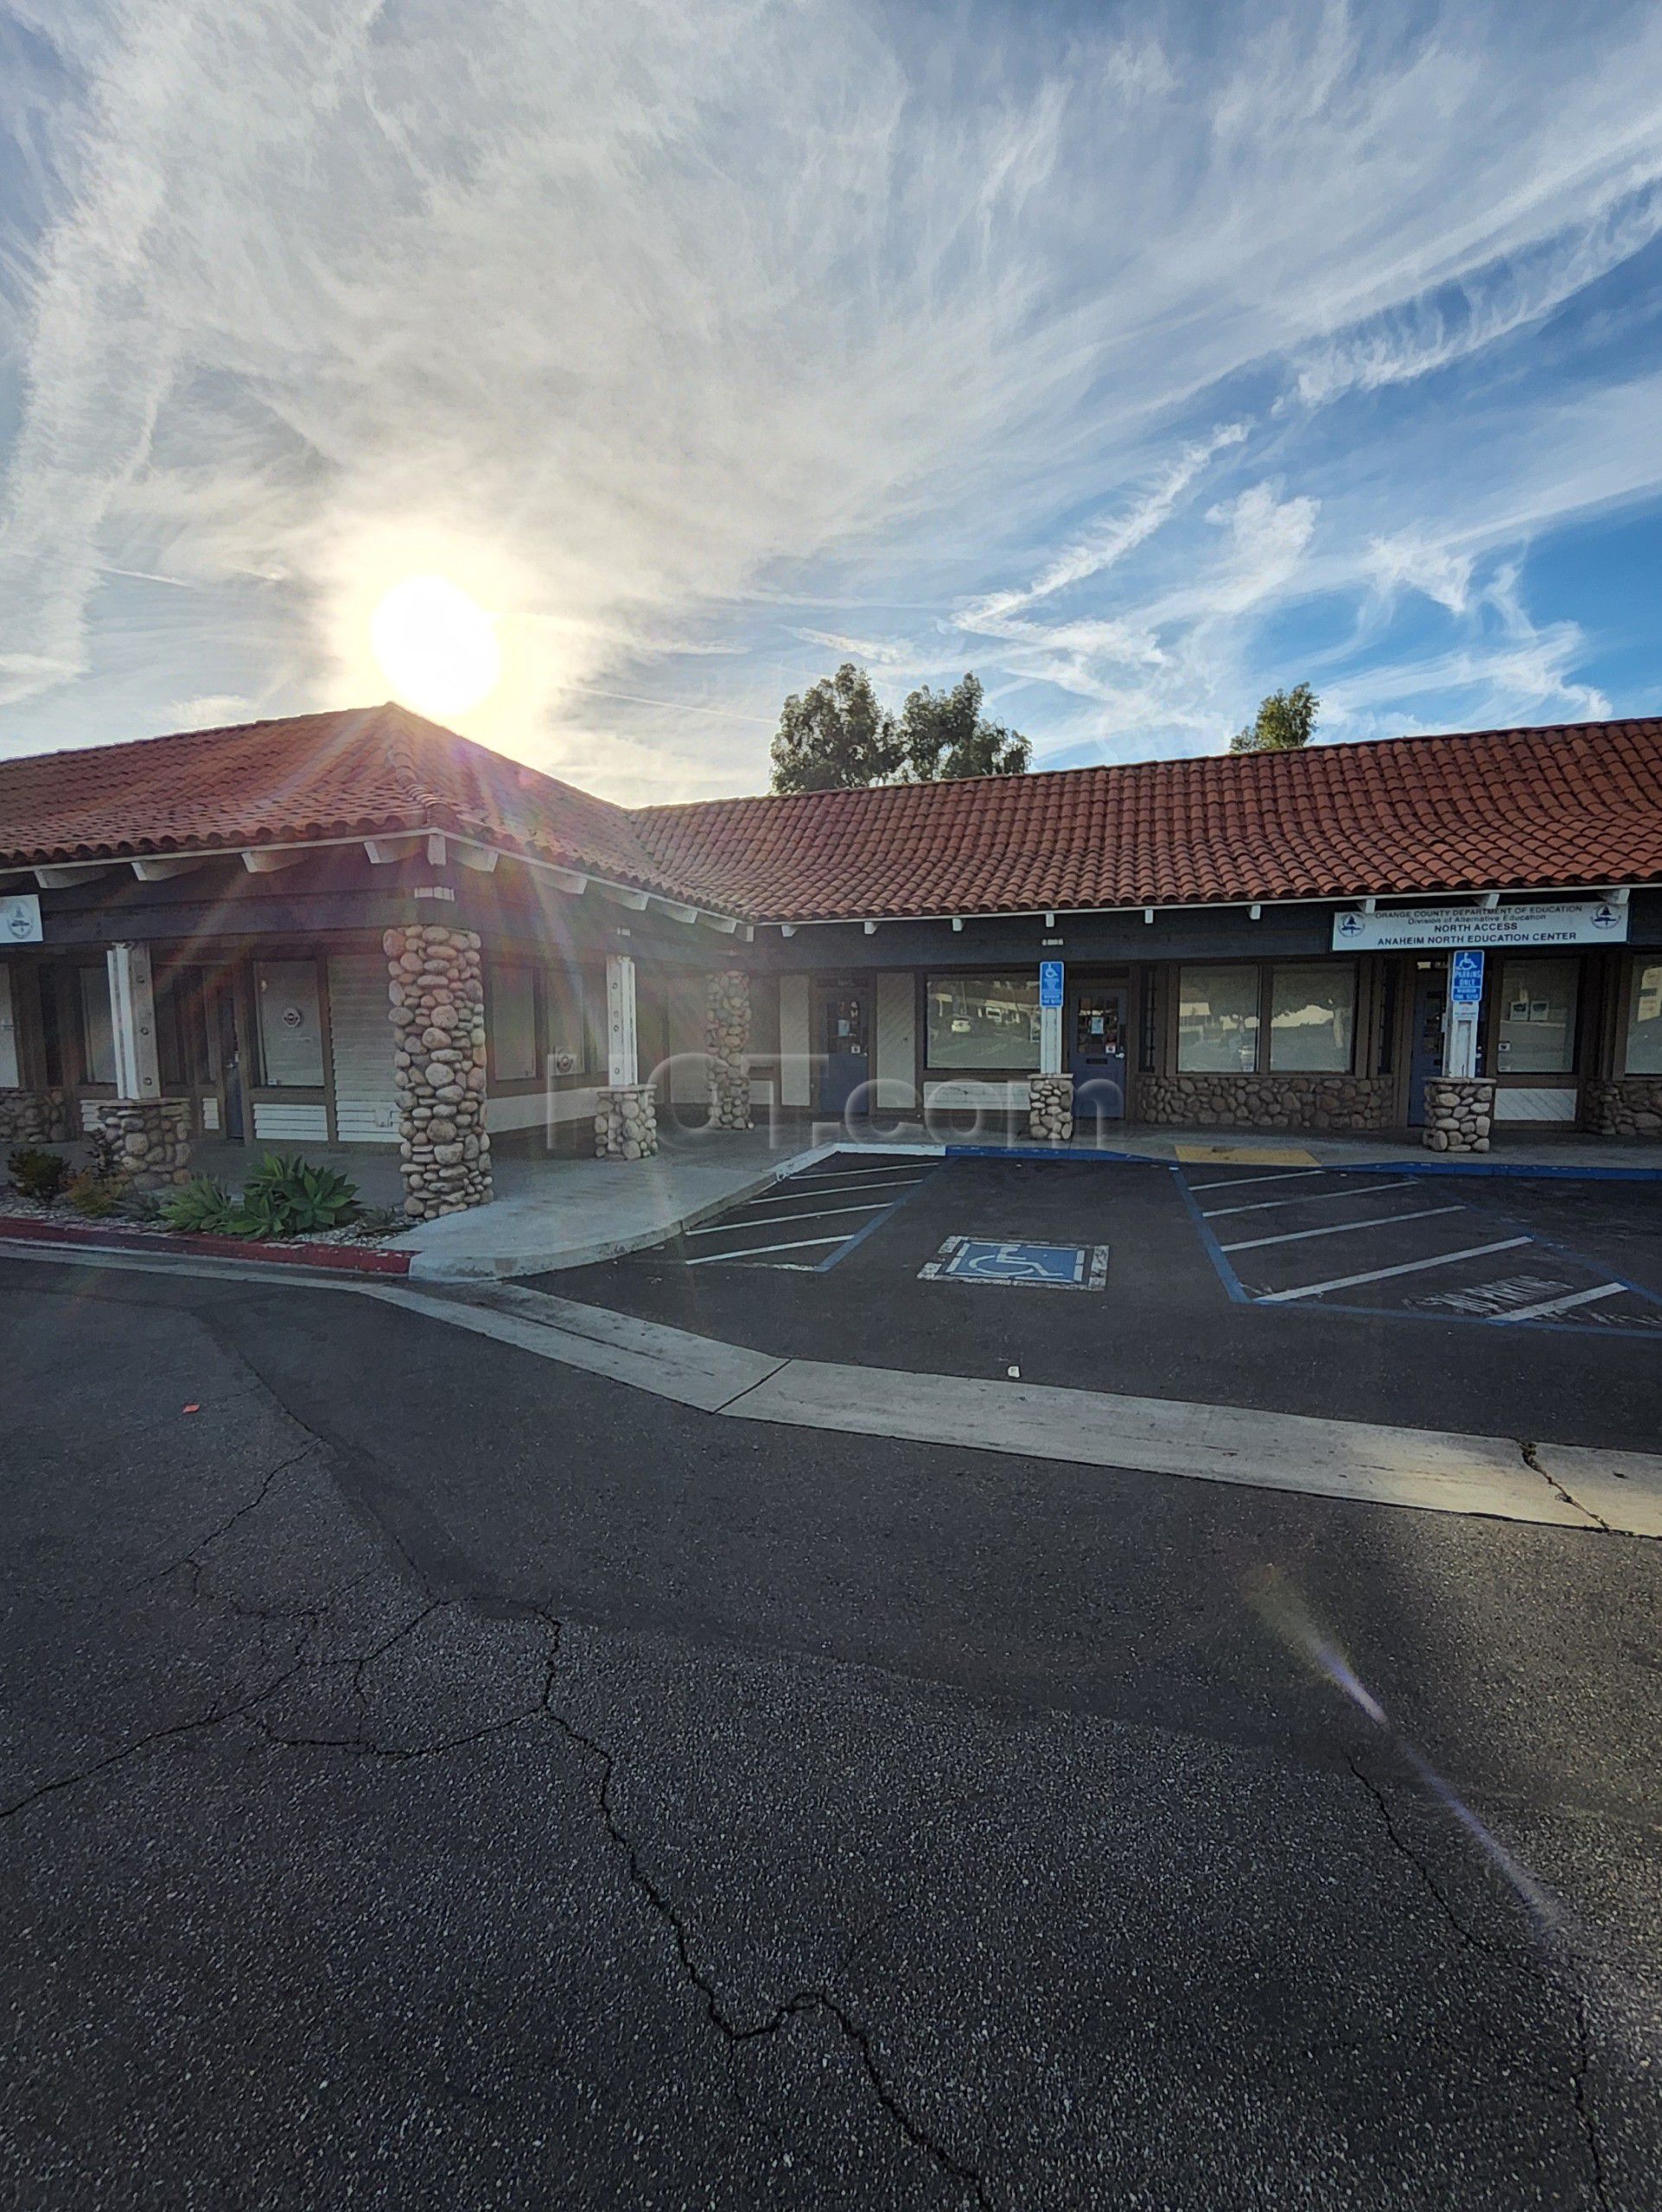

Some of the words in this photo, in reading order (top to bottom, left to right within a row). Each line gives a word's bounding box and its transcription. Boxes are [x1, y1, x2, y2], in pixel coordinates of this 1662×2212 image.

[1453, 907, 1512, 916] DEPARTMENT
[1474, 923, 1518, 931] ACCESS
[1428, 935, 1464, 944] NORTH
[1468, 934, 1529, 943] EDUCATION
[1532, 932, 1576, 941] CENTER
